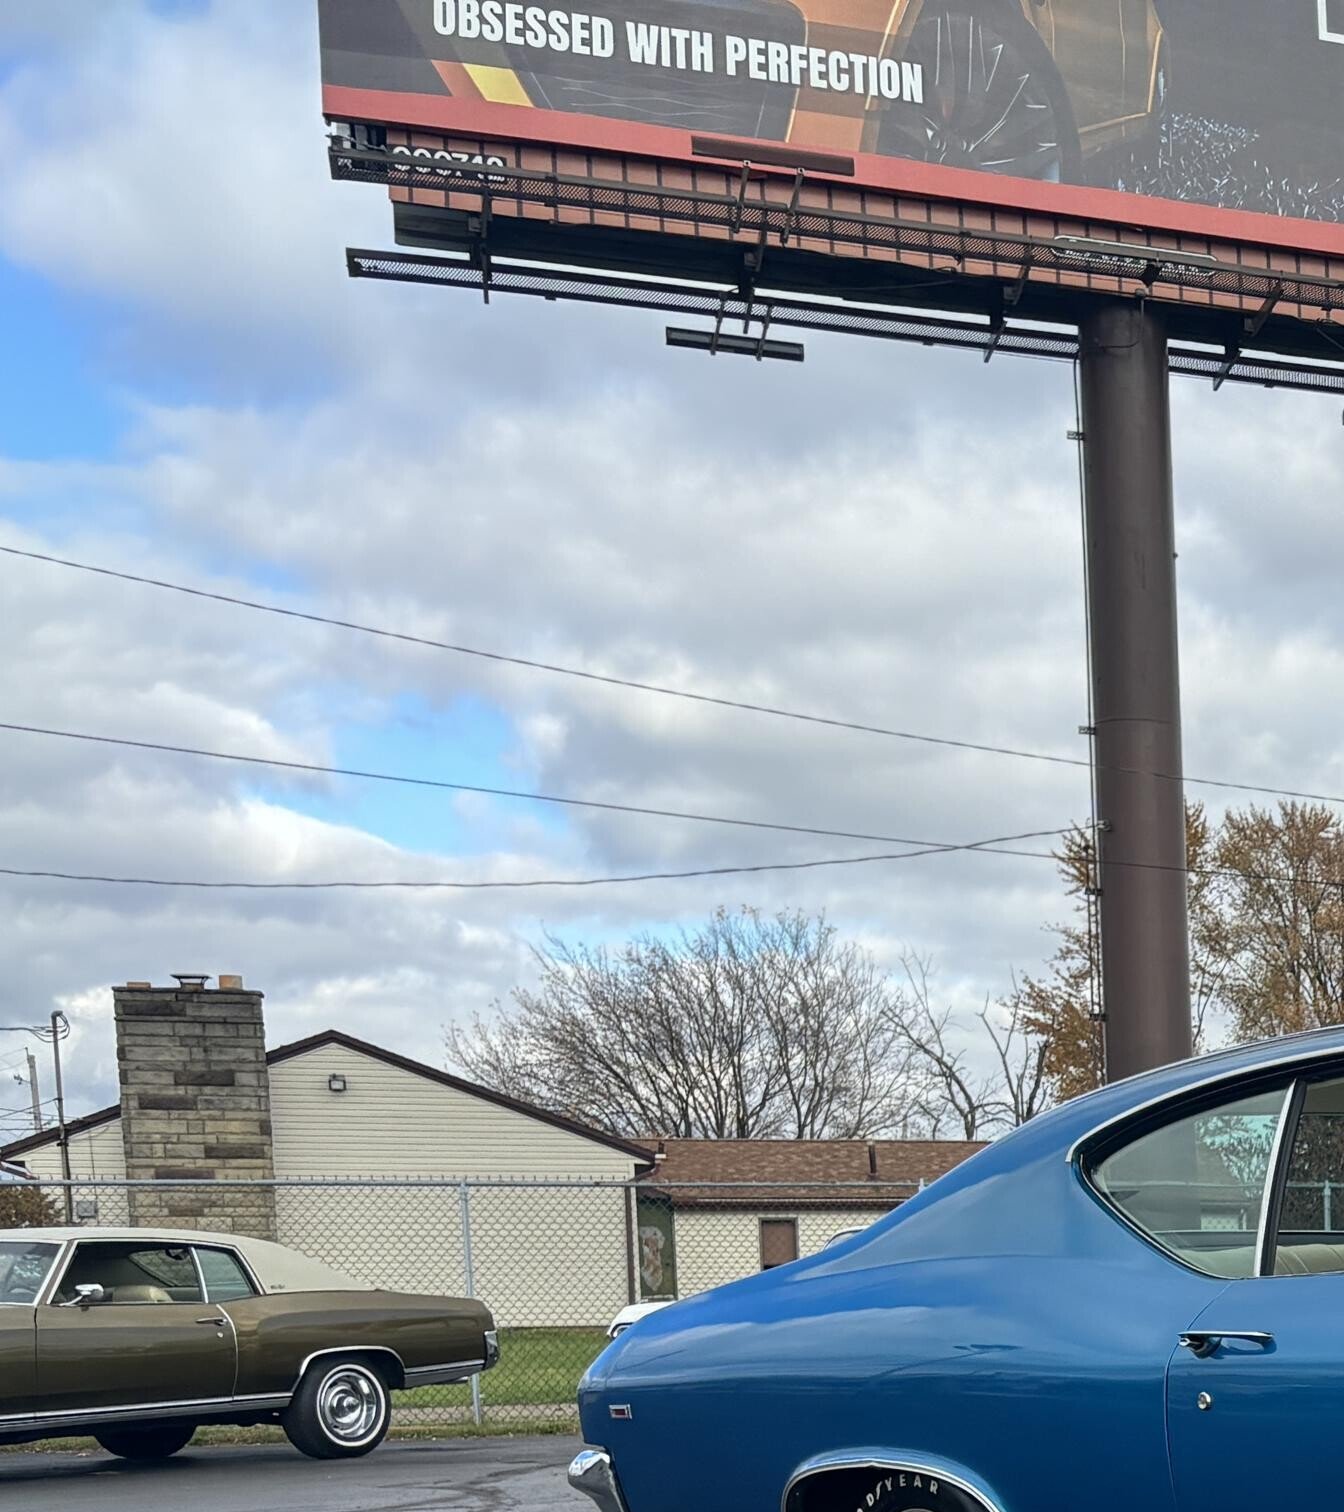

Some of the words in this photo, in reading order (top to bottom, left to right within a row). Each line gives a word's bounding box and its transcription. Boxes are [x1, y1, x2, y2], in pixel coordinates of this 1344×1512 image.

[433, 0, 614, 58] OBSESSED
[625, 20, 714, 73] WITH
[725, 34, 924, 104] PERFECTION
